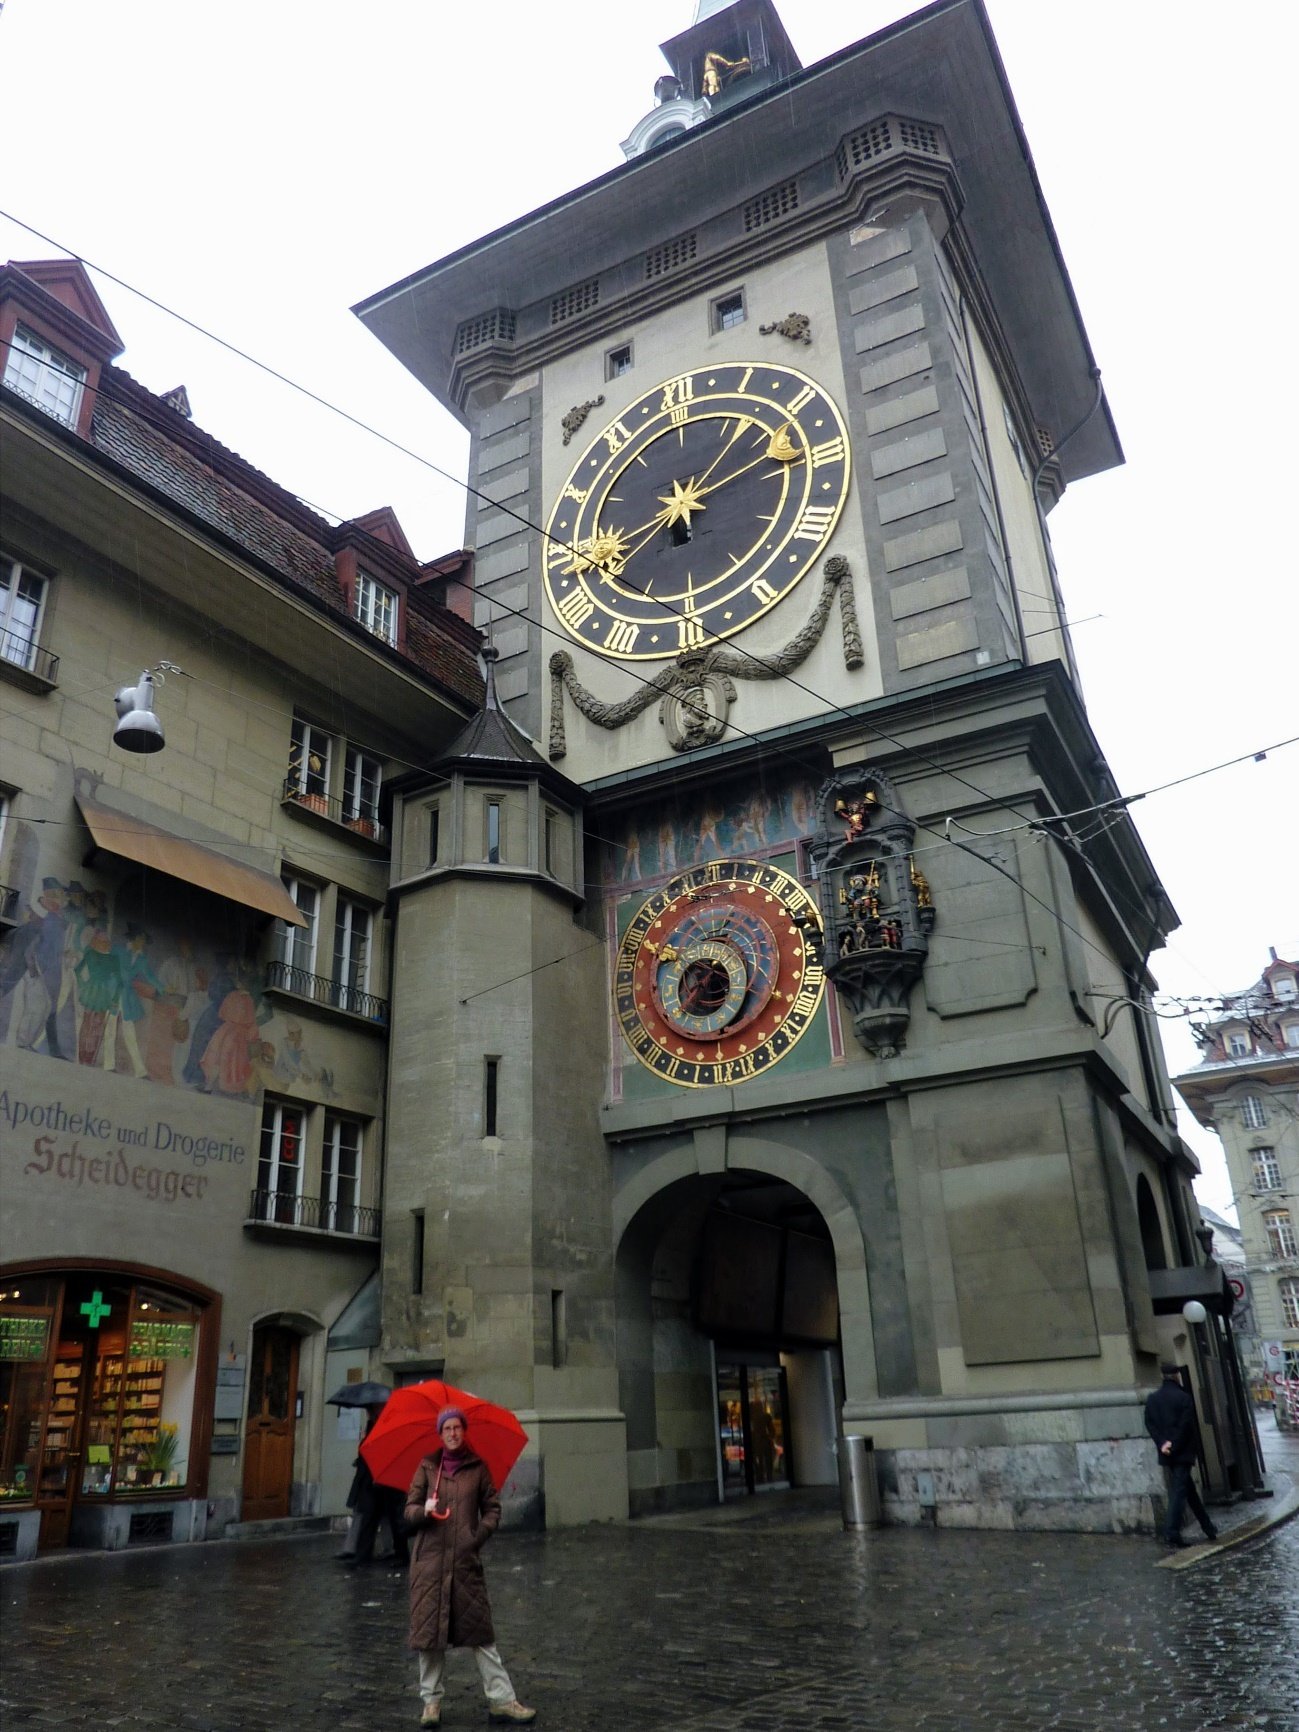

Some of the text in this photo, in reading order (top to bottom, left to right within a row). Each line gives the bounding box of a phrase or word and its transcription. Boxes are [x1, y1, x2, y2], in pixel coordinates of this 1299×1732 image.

[661, 376, 694, 411] XII
[737, 367, 754, 393] I
[786, 385, 816, 415] II
[603, 421, 632, 453] XI
[564, 483, 588, 503] X
[548, 541, 573, 569] IX
[0, 1089, 246, 1167] Apotheke und Drogerie
[24, 1134, 208, 1202] Scheidegger
